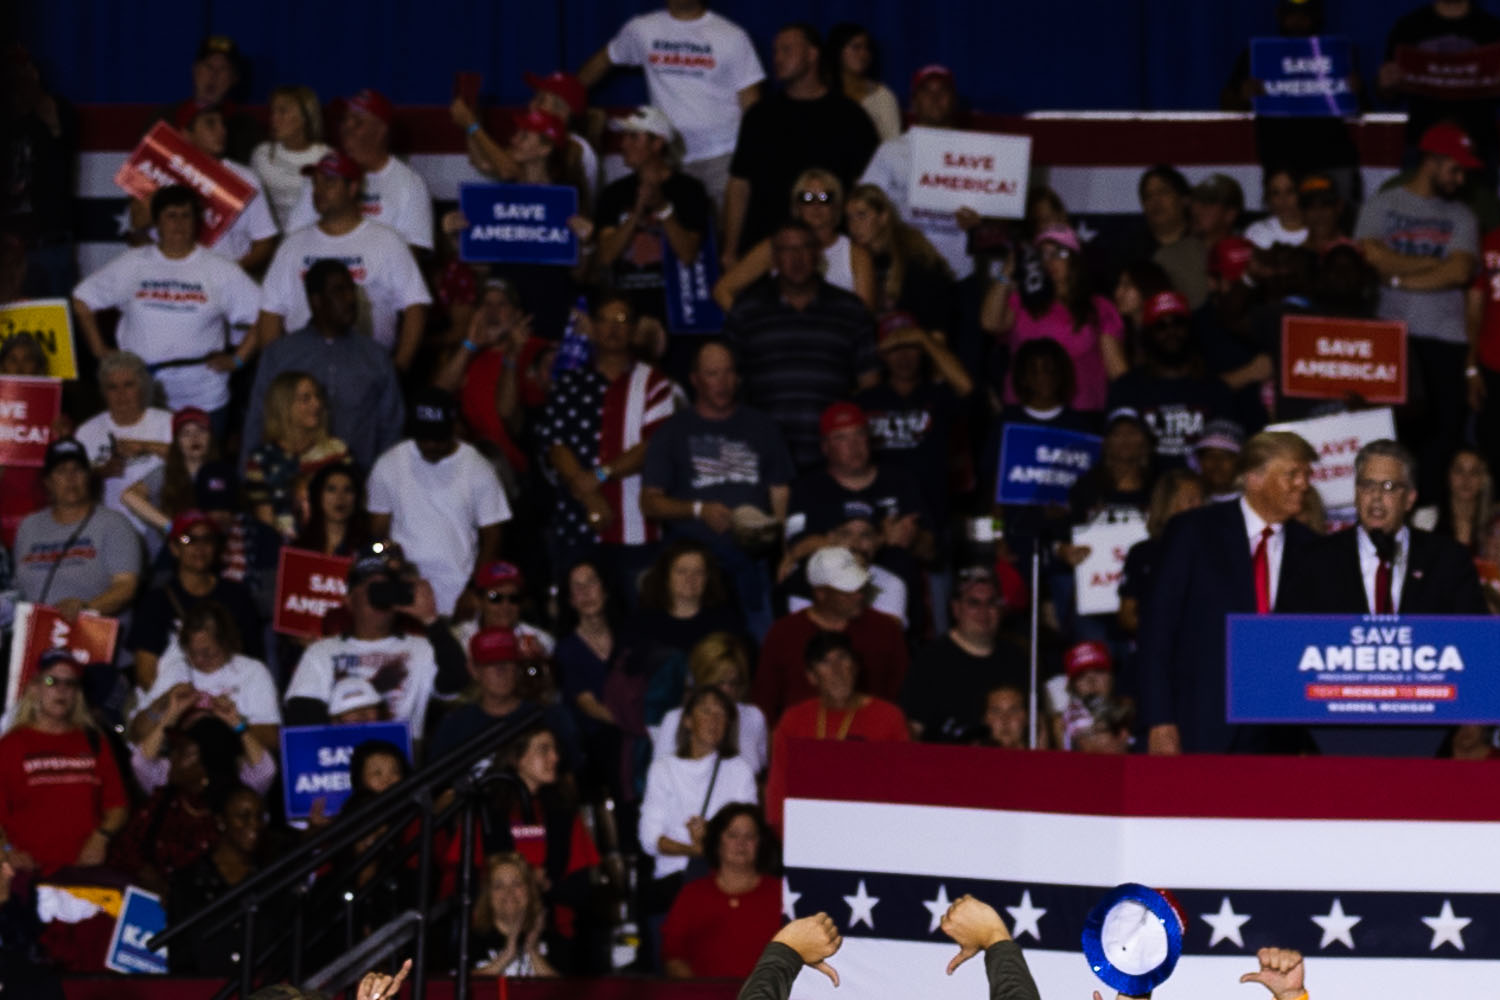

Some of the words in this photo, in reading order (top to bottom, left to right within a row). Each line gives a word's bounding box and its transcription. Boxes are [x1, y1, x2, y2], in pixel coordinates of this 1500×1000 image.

[943, 152, 994, 172] SAVE
[919, 173, 1017, 197] AMERICA!
[493, 202, 547, 223] SAVE
[471, 223, 571, 246] AMERICA!
[1315, 337, 1373, 360] SAVE
[1292, 358, 1398, 384] AMERICA!
[1352, 626, 1412, 644] SAVE
[1299, 645, 1464, 671] AMERICA
